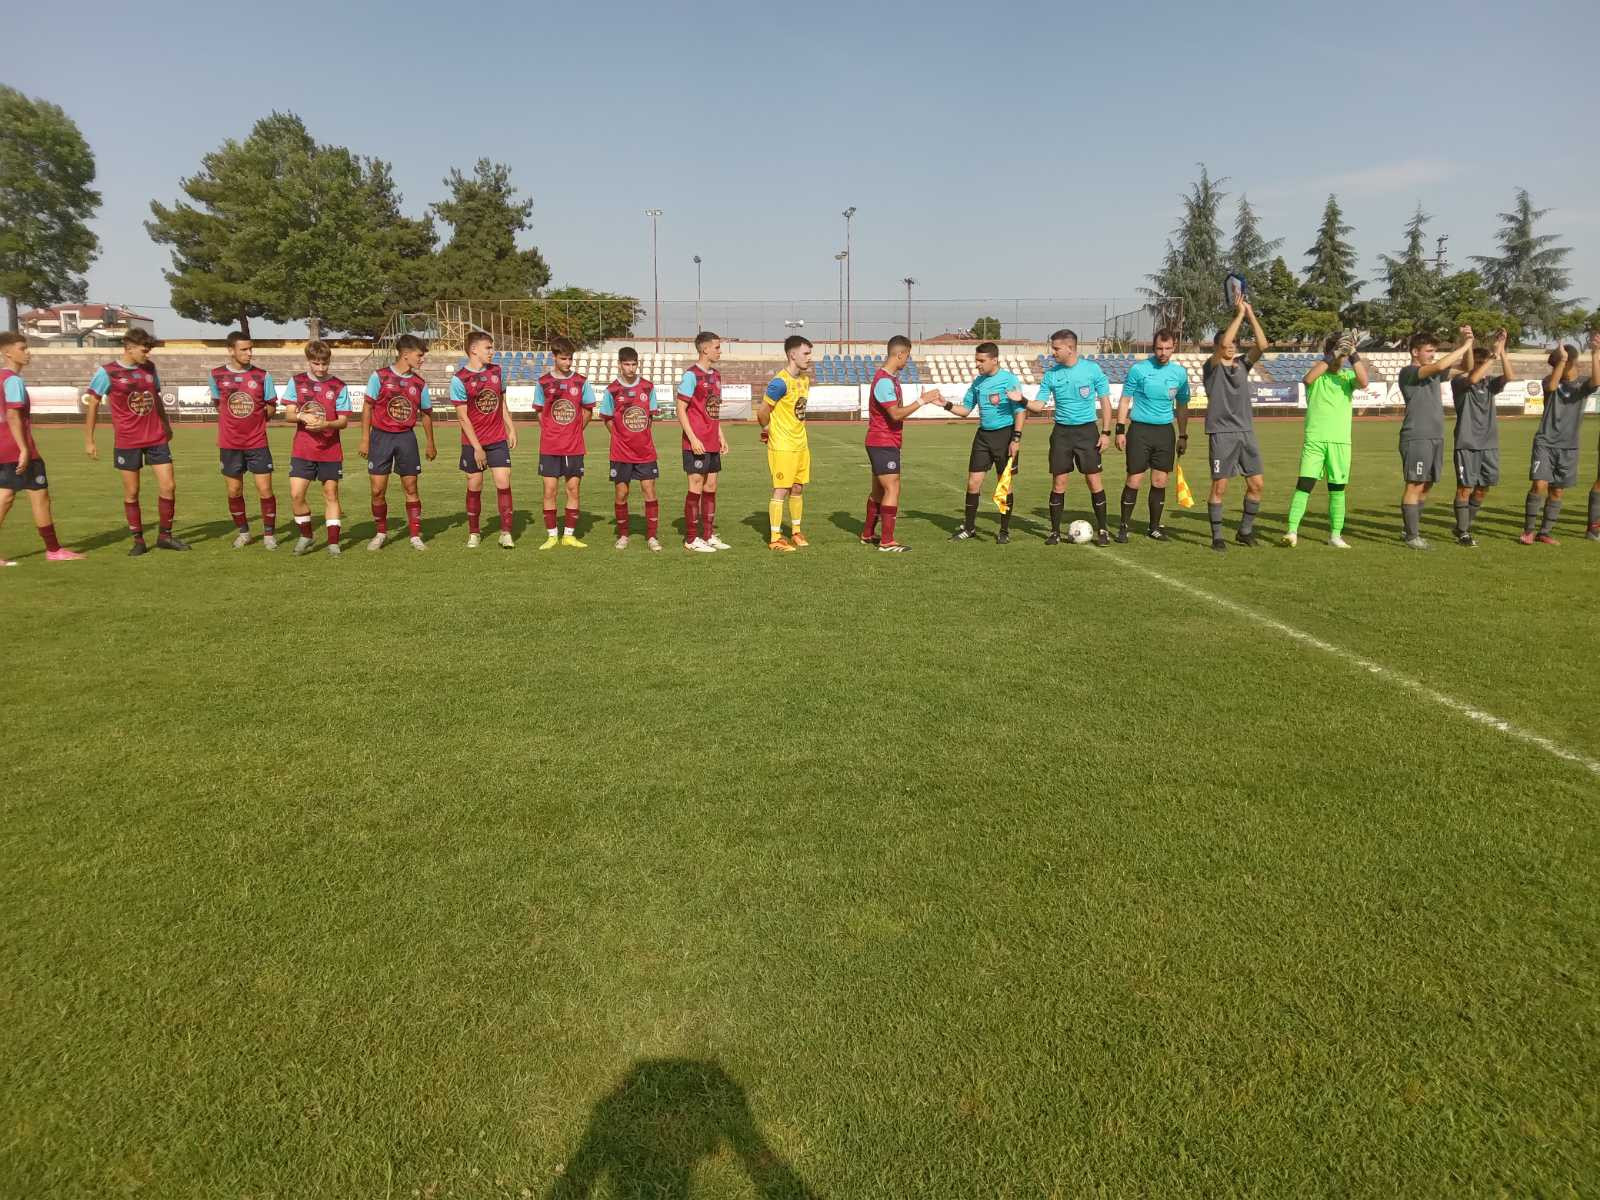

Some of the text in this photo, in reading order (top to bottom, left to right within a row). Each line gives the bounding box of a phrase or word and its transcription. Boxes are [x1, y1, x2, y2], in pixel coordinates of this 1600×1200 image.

[1214, 460, 1220, 473] 3
[1416, 461, 1424, 475] 6
[1534, 460, 1541, 473] 7
